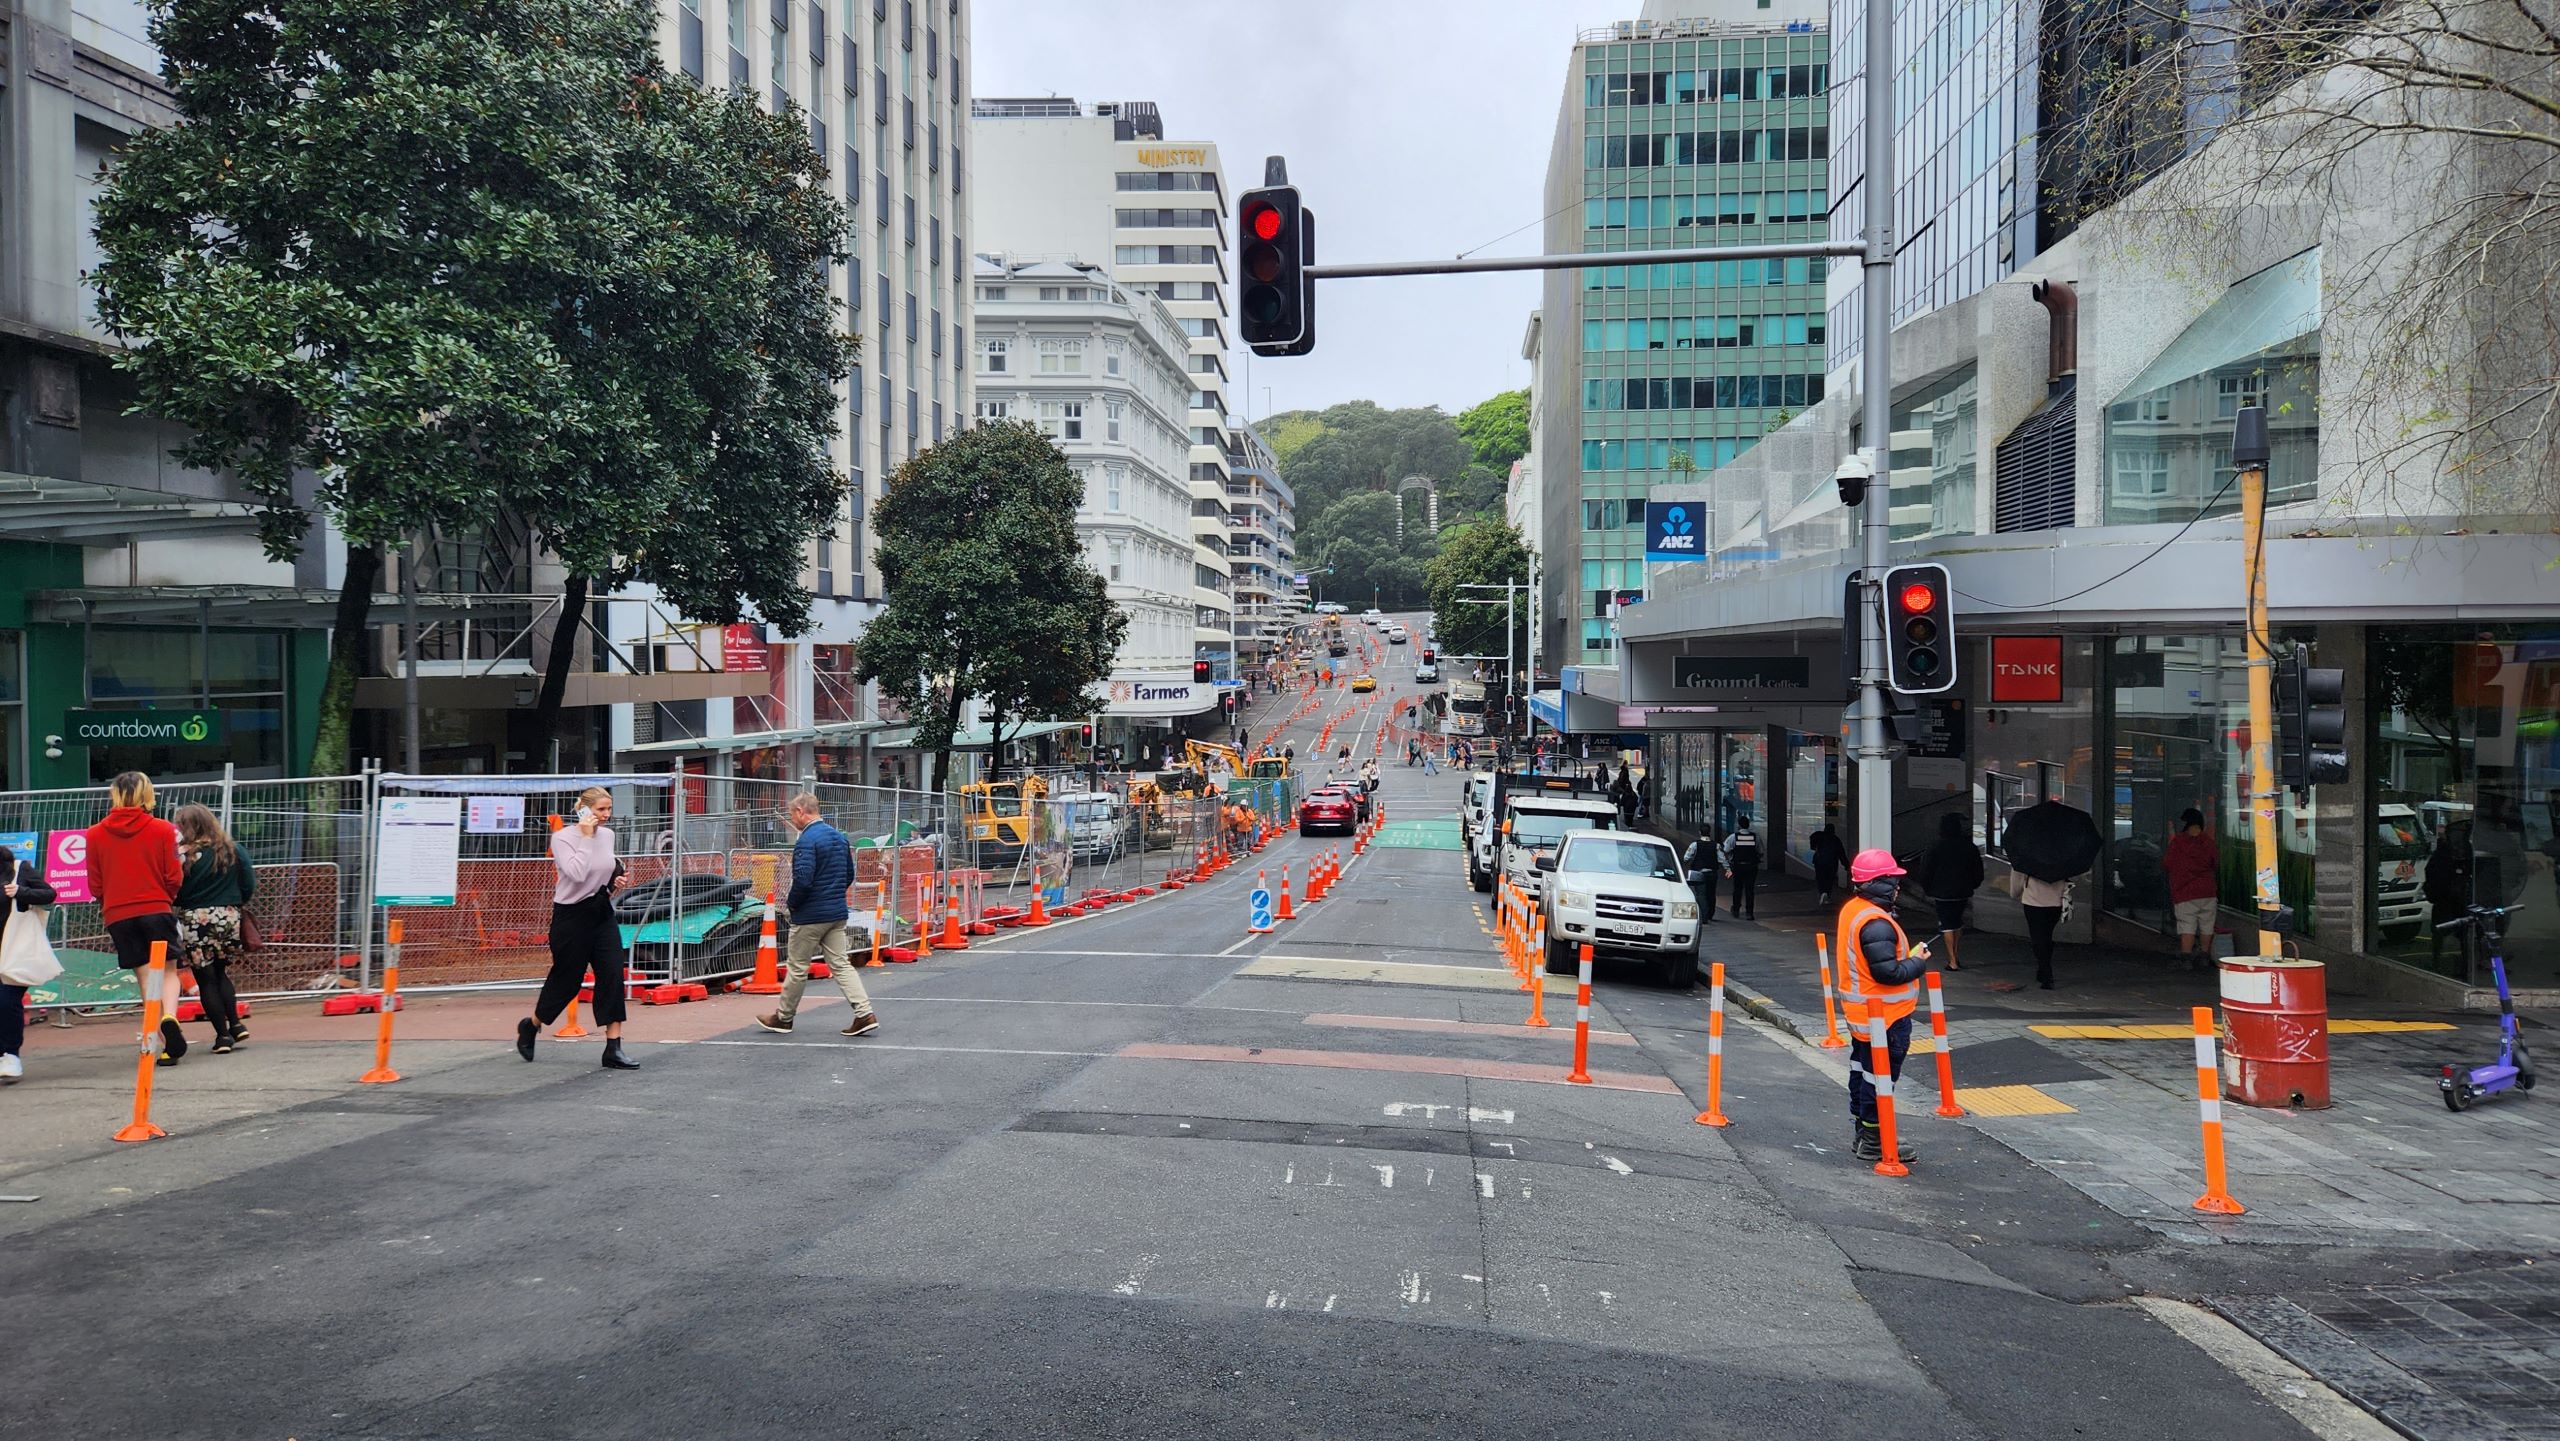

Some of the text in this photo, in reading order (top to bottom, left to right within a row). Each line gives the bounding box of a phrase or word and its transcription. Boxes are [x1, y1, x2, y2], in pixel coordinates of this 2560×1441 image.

[1138, 149, 1206, 168] MINISTRY
[1658, 535, 1694, 549] ANZ
[724, 630, 735, 646] For
[1997, 664, 2056, 675] TANK
[1134, 683, 1190, 700] Farmers
[79, 718, 177, 738] countdown
[60, 889, 81, 898] usual
